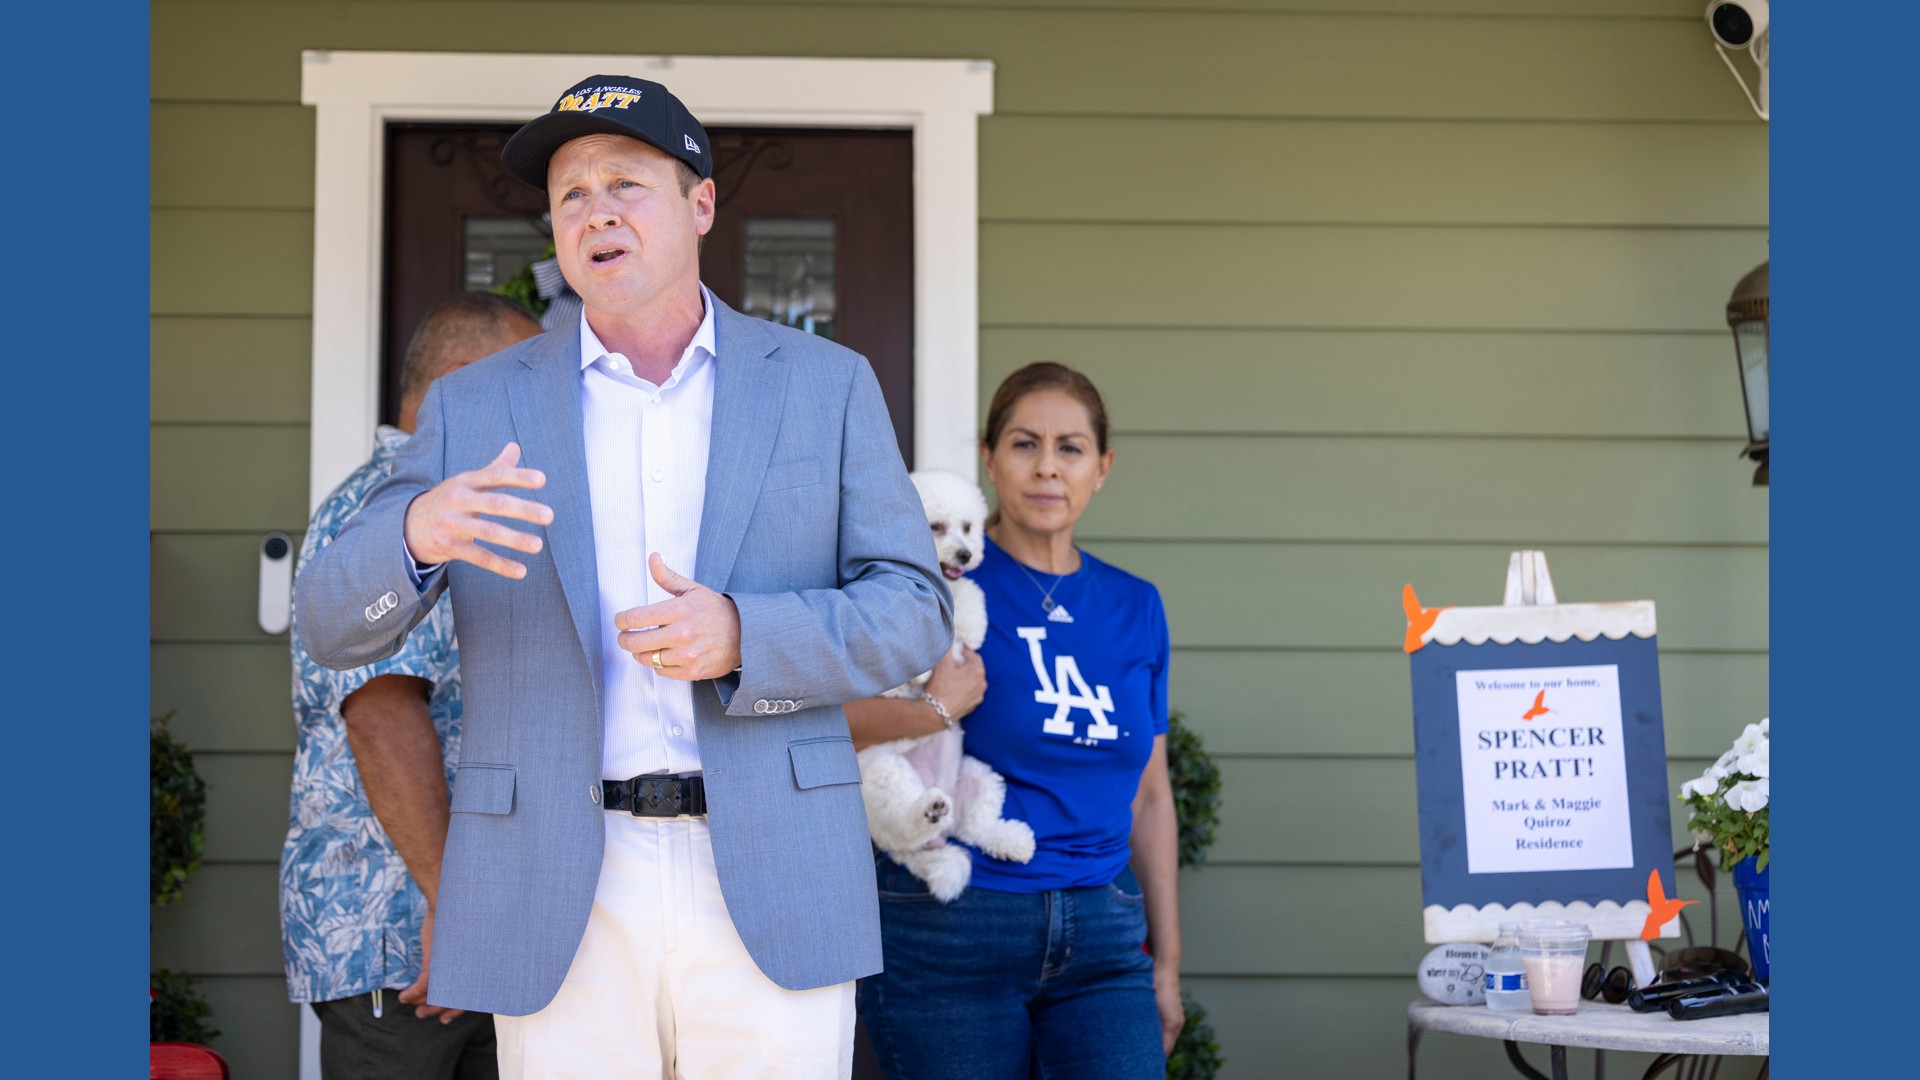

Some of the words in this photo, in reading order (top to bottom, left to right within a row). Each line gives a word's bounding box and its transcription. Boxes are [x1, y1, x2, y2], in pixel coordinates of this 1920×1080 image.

[575, 87, 593, 98] LOS
[592, 86, 642, 96] ANGELES
[1016, 626, 1119, 740] LA
[1475, 680, 1526, 691] Welcome
[1529, 679, 1540, 689] to
[1543, 680, 1563, 689] our
[1478, 726, 1606, 750] SPENCER
[1494, 757, 1594, 780] PRATT!
[1492, 798, 1530, 812] Mark
[1534, 799, 1546, 811] &
[1552, 796, 1602, 812] Maggie
[1524, 815, 1572, 830] Quiroz
[1516, 836, 1584, 850] Residence
[1445, 949, 1478, 959] Home
